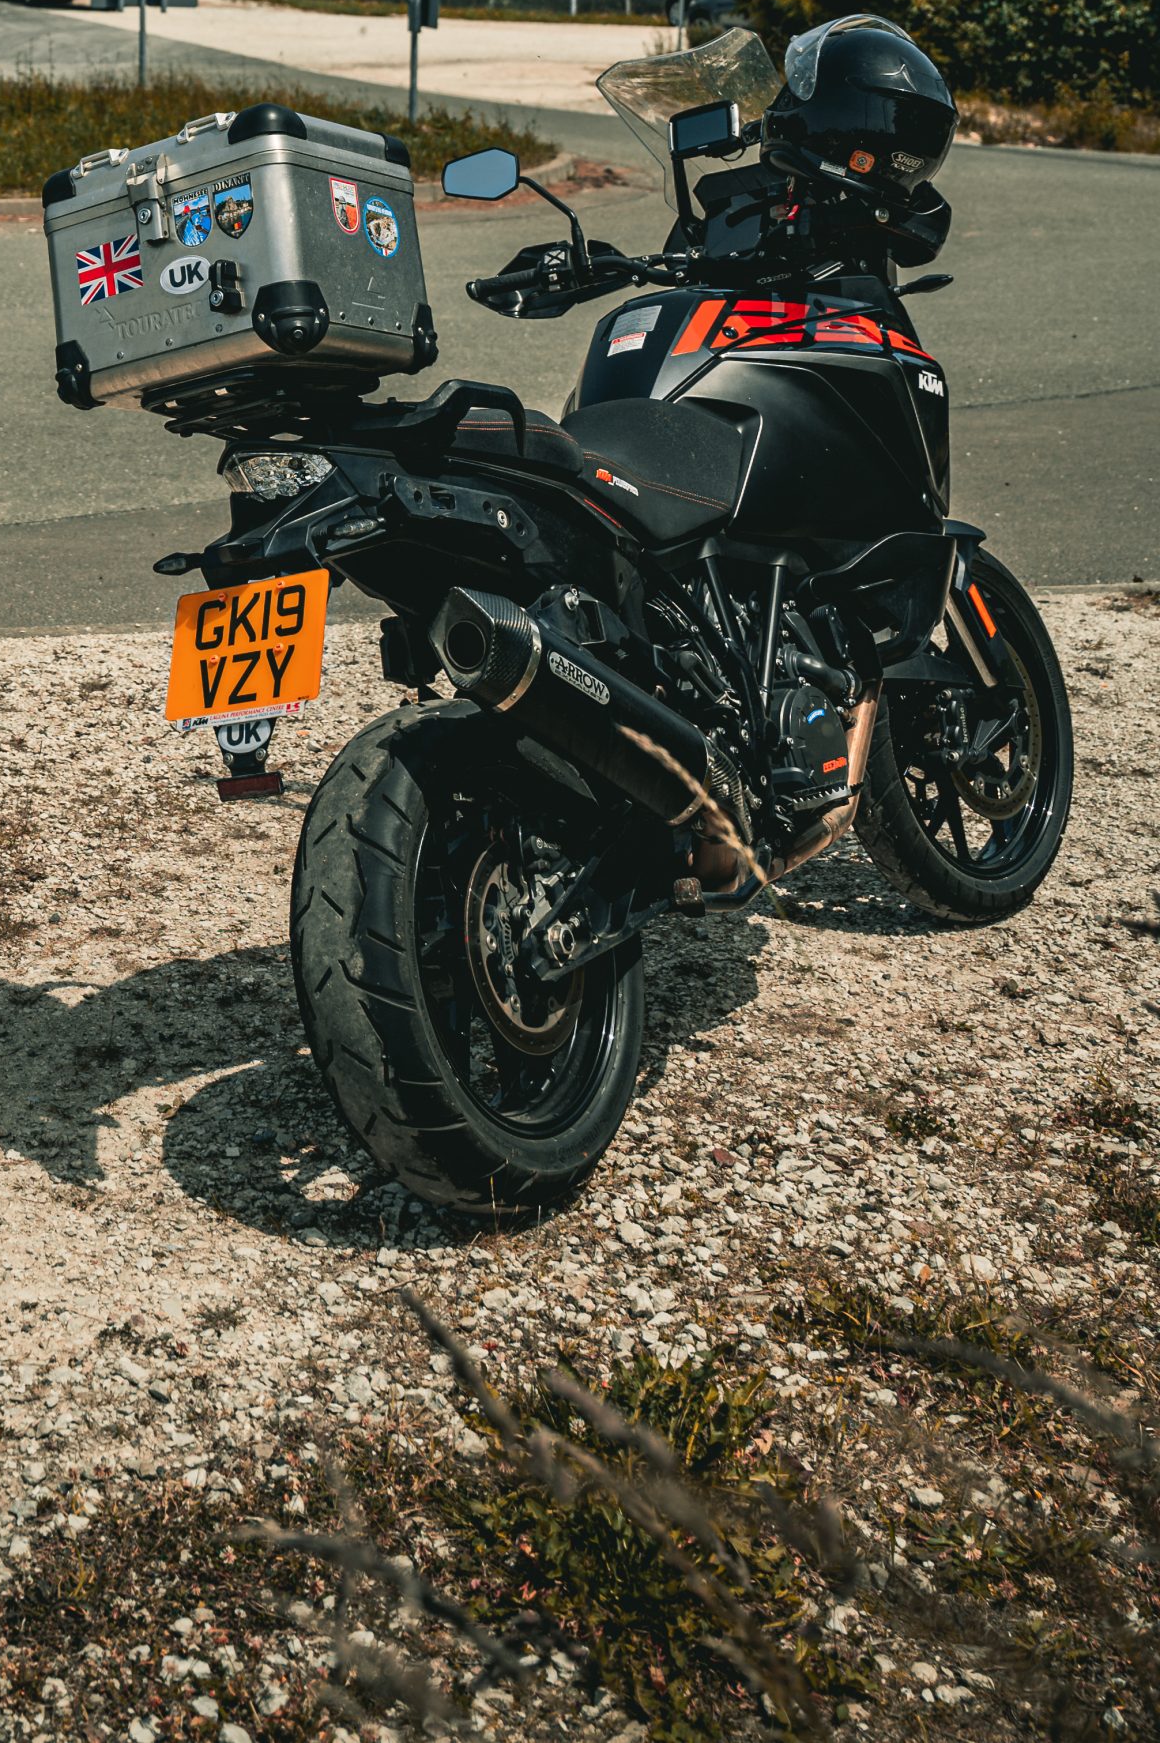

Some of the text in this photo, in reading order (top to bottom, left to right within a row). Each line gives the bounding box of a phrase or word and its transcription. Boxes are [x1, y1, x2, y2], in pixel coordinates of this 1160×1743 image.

[895, 153, 921, 167] SHOEI
[213, 174, 249, 192] DINANT
[169, 261, 204, 288] UK
[918, 370, 944, 397] KTM
[195, 584, 306, 651] GK19
[200, 644, 295, 709] VZY
[555, 657, 605, 696] ARROW
[192, 717, 208, 726] KTM
[230, 708, 265, 718] PERFORMANCE
[960, 706, 969, 743] brembo
[226, 722, 261, 746] UK
